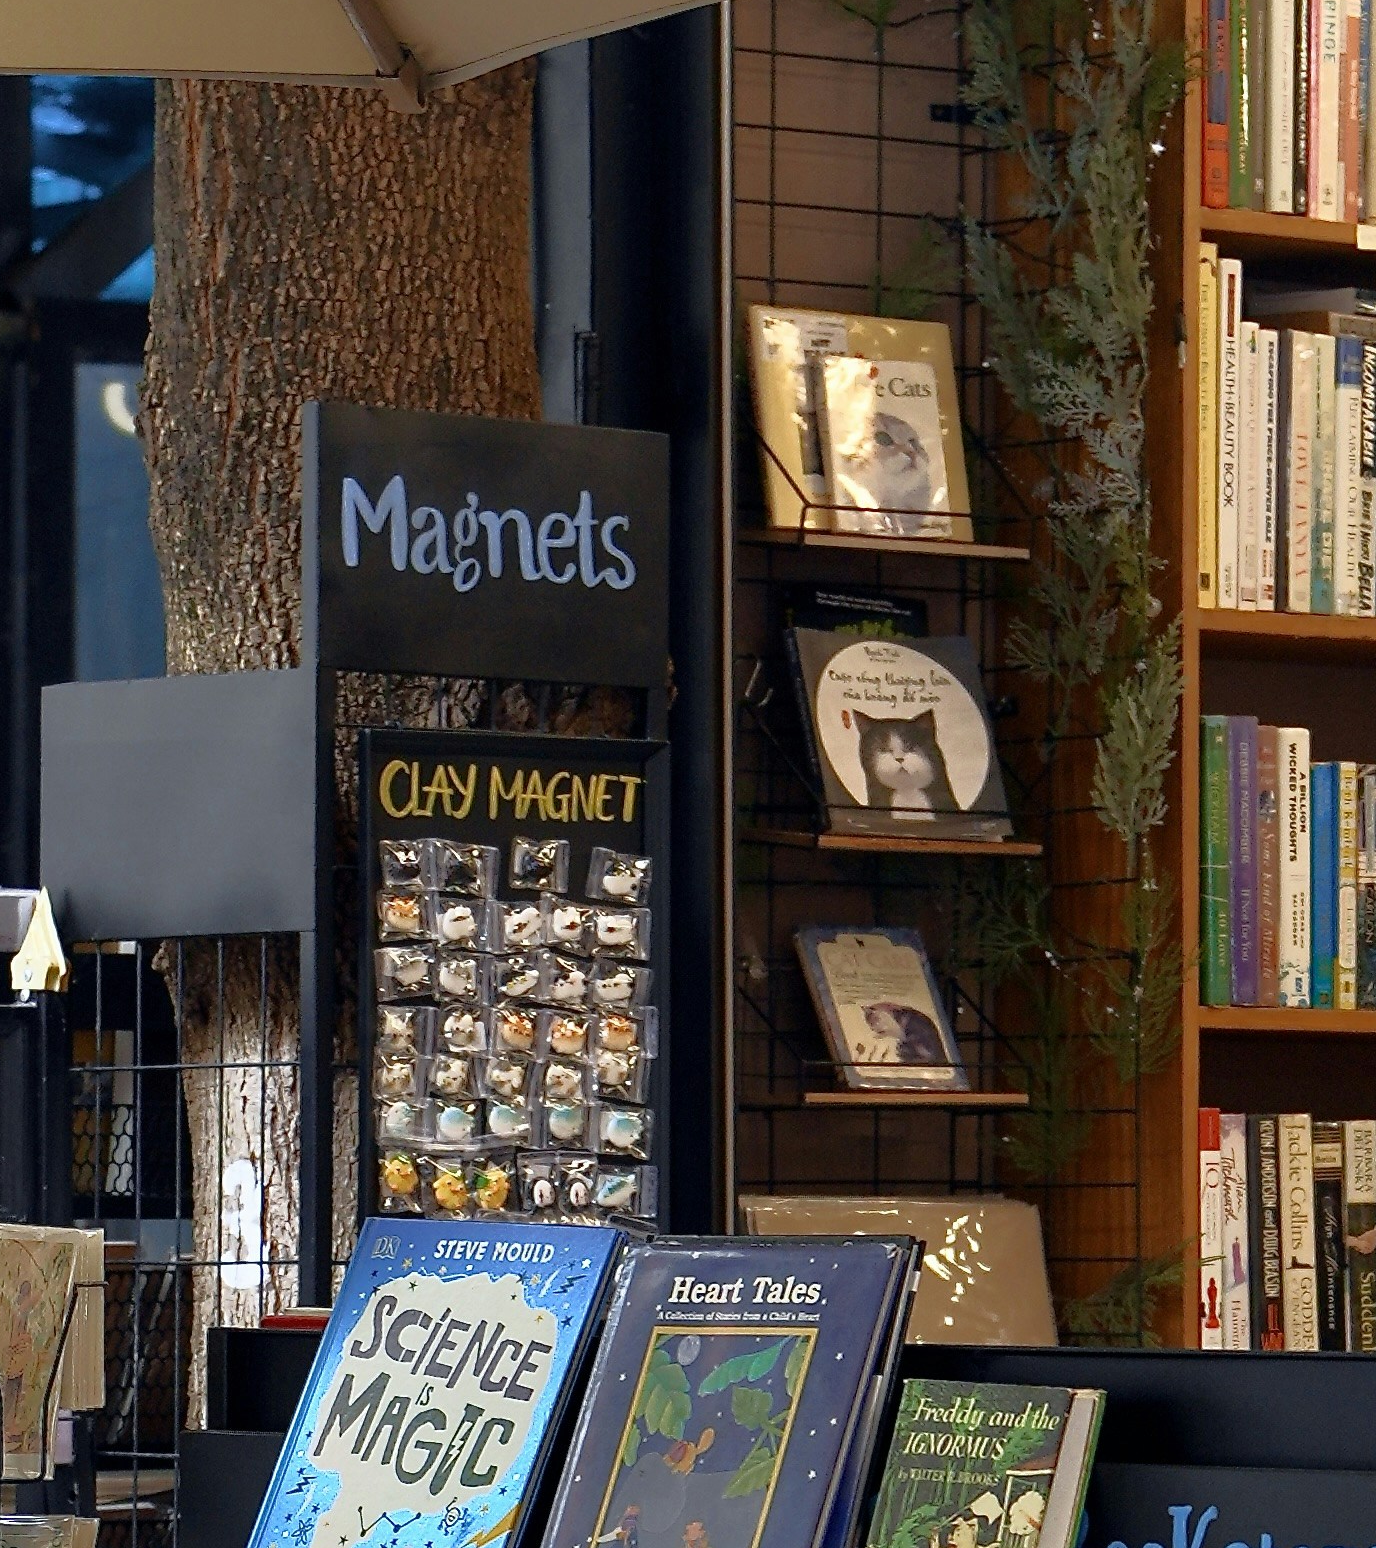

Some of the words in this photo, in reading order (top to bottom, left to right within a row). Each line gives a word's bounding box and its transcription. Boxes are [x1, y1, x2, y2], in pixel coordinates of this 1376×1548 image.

[888, 377, 932, 399] Cats
[341, 474, 638, 594] Magnets
[1287, 742, 1298, 802] WICKED
[379, 758, 477, 820] CLAY
[488, 772, 643, 824] MAGNET
[1287, 806, 1298, 863] THOUGHTS
[373, 1237, 400, 1259] DK
[433, 1239, 489, 1261] STEVE
[492, 1242, 555, 1263] MOULD
[668, 1276, 745, 1304] Heart
[665, 1311, 705, 1321] Collection
[706, 1312, 714, 1321] of
[350, 1295, 553, 1402] SCIENCE
[415, 1383, 434, 1406] IS
[913, 1397, 986, 1431] Freddy
[987, 1401, 1033, 1428] and
[1031, 1402, 1061, 1431] the
[313, 1371, 515, 1496] MAGIC
[903, 1431, 1008, 1461] IGNORMUS
